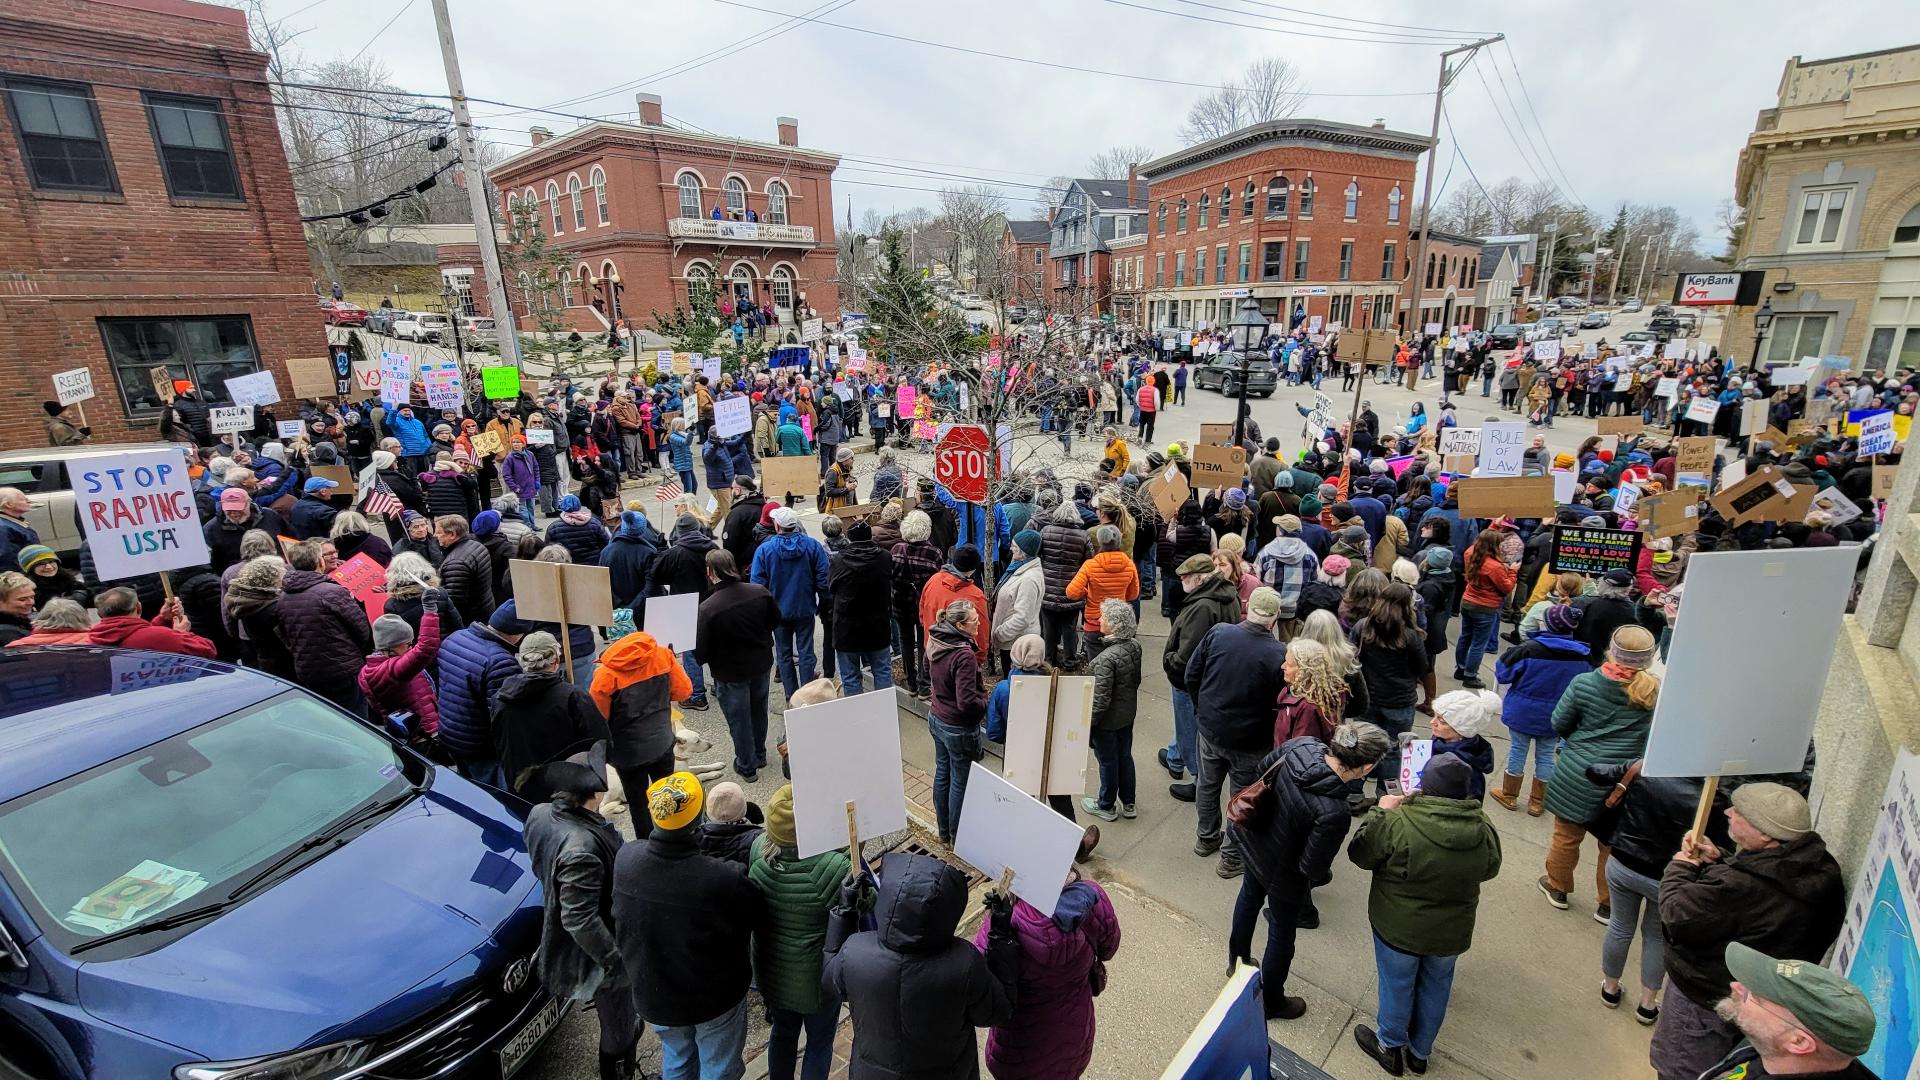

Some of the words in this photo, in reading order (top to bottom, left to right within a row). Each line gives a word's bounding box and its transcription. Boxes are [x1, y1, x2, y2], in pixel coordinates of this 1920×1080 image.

[1688, 275, 1735, 287] KeyBank
[387, 357, 405, 367] DUE
[58, 370, 88, 390] REJECT
[430, 392, 459, 402] HANDS
[437, 400, 453, 408] OFF
[215, 407, 247, 419] RUSSIA
[1862, 421, 1891, 436] AMERICA
[1449, 430, 1480, 441] TRUTH
[1491, 429, 1524, 445] RULE
[1860, 435, 1884, 448] GREAT
[1443, 441, 1478, 454] MATTERS
[1495, 447, 1511, 456] OF
[1860, 440, 1892, 456] ALREADY
[1193, 461, 1223, 472] WELL
[1487, 458, 1519, 472] LAW
[1680, 461, 1709, 471] PEOPLE
[83, 464, 173, 494] STOP
[88, 490, 191, 531] RAPING
[1561, 529, 1580, 537] WE
[1584, 531, 1635, 542] BELIEVE
[1559, 546, 1586, 554] LOVE
[1603, 549, 1631, 557] LOVE
[1556, 562, 1589, 570] WATER
[1557, 556, 1592, 565] SCIENCE
[1607, 561, 1629, 569] REAL
[514, 1022, 541, 1059] 8680
[543, 1004, 557, 1029] WN
